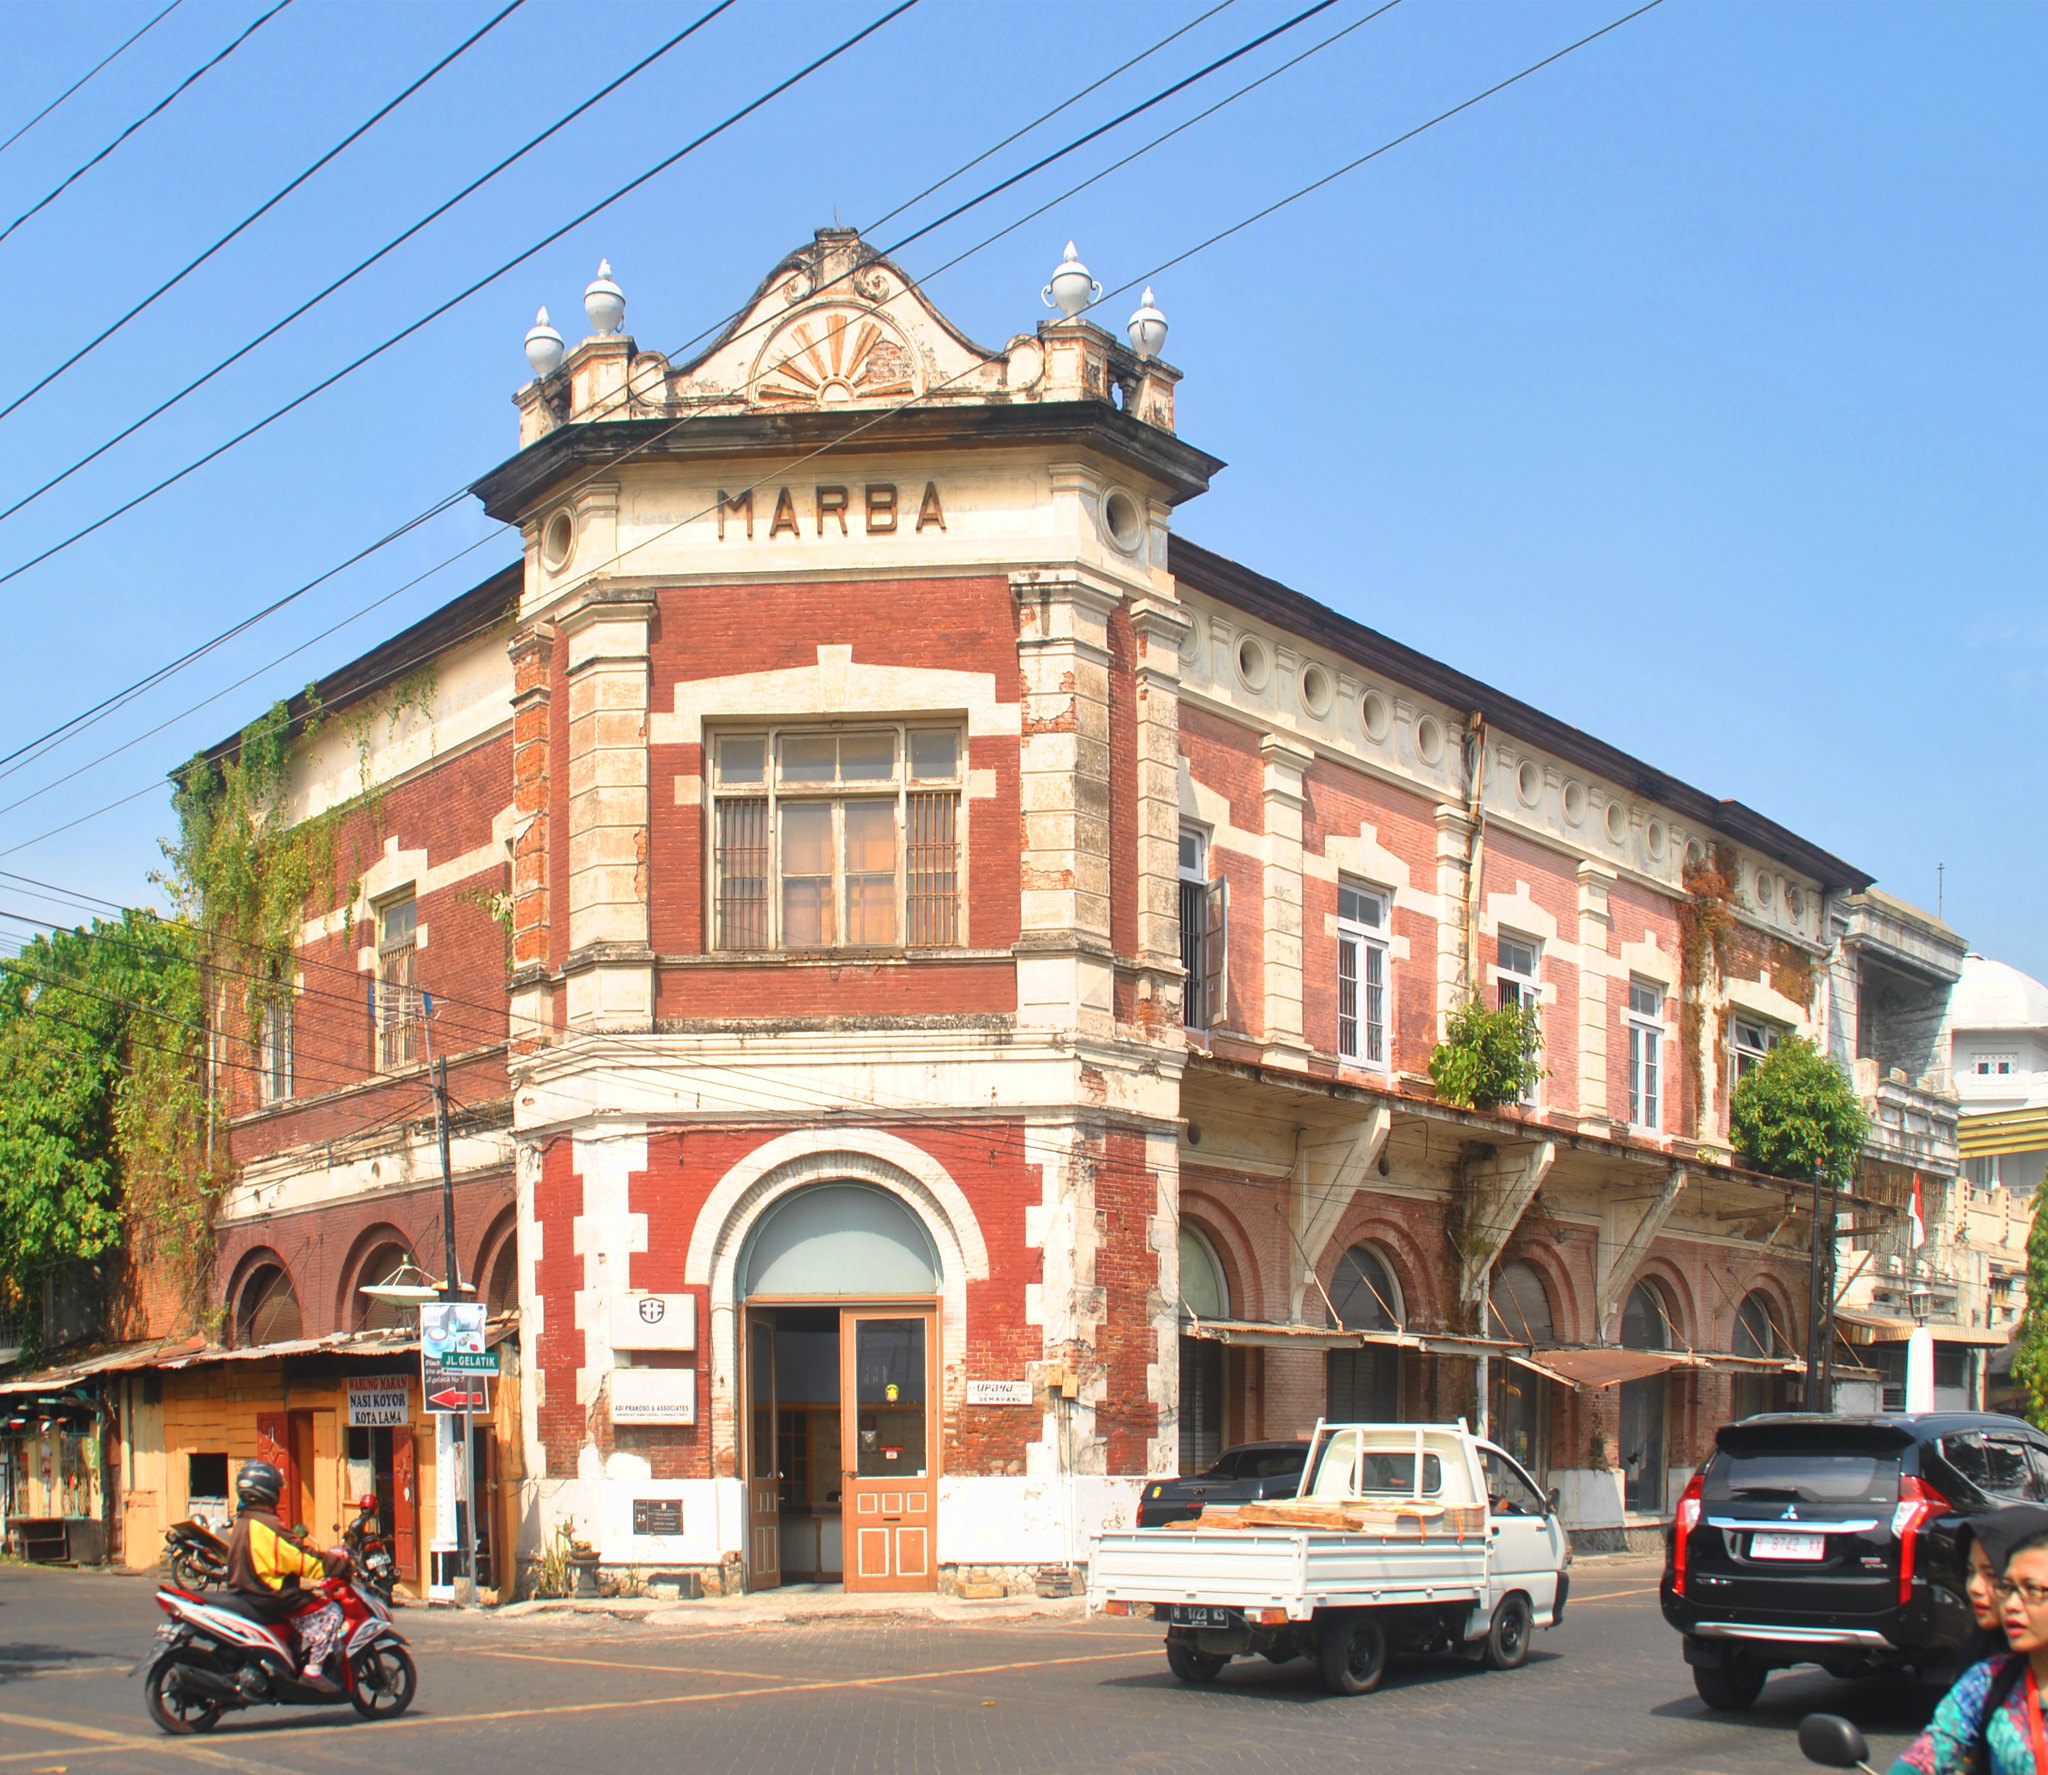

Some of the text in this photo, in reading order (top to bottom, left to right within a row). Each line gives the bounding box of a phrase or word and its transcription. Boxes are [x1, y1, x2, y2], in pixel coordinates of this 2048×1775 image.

[717, 480, 947, 539] MARBA
[459, 1356, 495, 1367] GELATIK
[349, 1375, 407, 1391] WARUNG MAKAN
[350, 1393, 406, 1408] NASI KOYOR
[355, 1410, 402, 1424] KOTA LAMA
[1755, 1536, 1763, 1550] H
